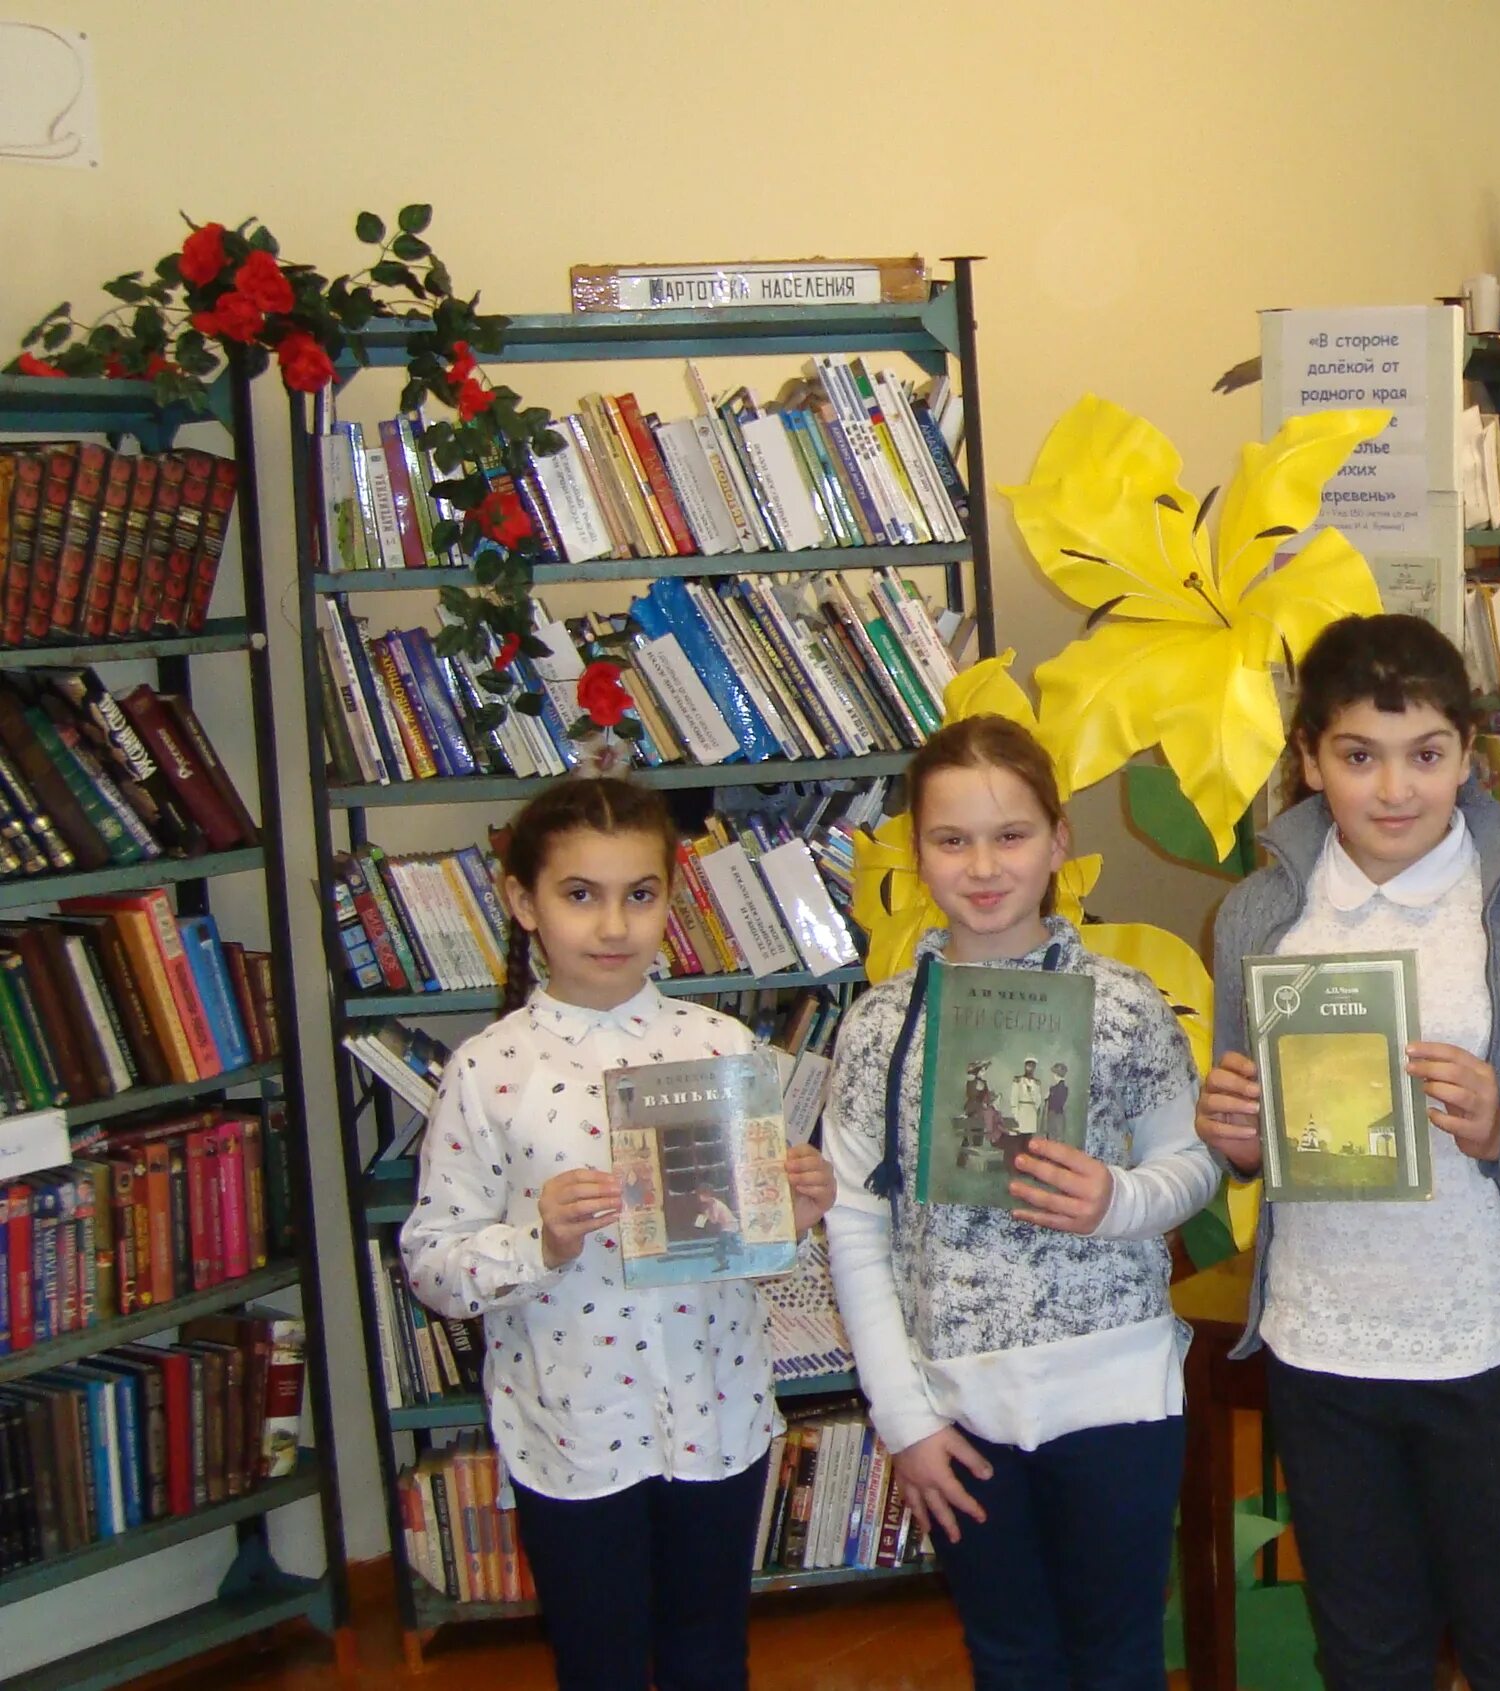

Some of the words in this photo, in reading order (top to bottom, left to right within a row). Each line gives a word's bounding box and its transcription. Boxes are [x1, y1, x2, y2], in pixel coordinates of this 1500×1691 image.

[762, 277, 855, 298] НАСЕЛЕНИЯ
[1336, 335, 1399, 350] стороне
[1308, 359, 1374, 376] далёкой
[1382, 362, 1399, 373] от
[1301, 388, 1365, 405] родного
[1373, 389, 1407, 404] края
[1353, 441, 1390, 454] олье
[1337, 464, 1376, 476] ихих
[372, 473, 394, 534] МАТЕМАТИКА
[748, 616, 783, 670] АКВАРИУМ
[381, 653, 417, 724] ЖИВОТНЫХ
[480, 890, 511, 941] Физика
[998, 990, 1048, 1002] ЧЕХОВ
[953, 1006, 985, 1027] ТРИ
[993, 1007, 1063, 1033] СЕСТРЫ
[1319, 1003, 1367, 1017] СТЕПЬ
[643, 1087, 735, 1108] ВАНЬКА
